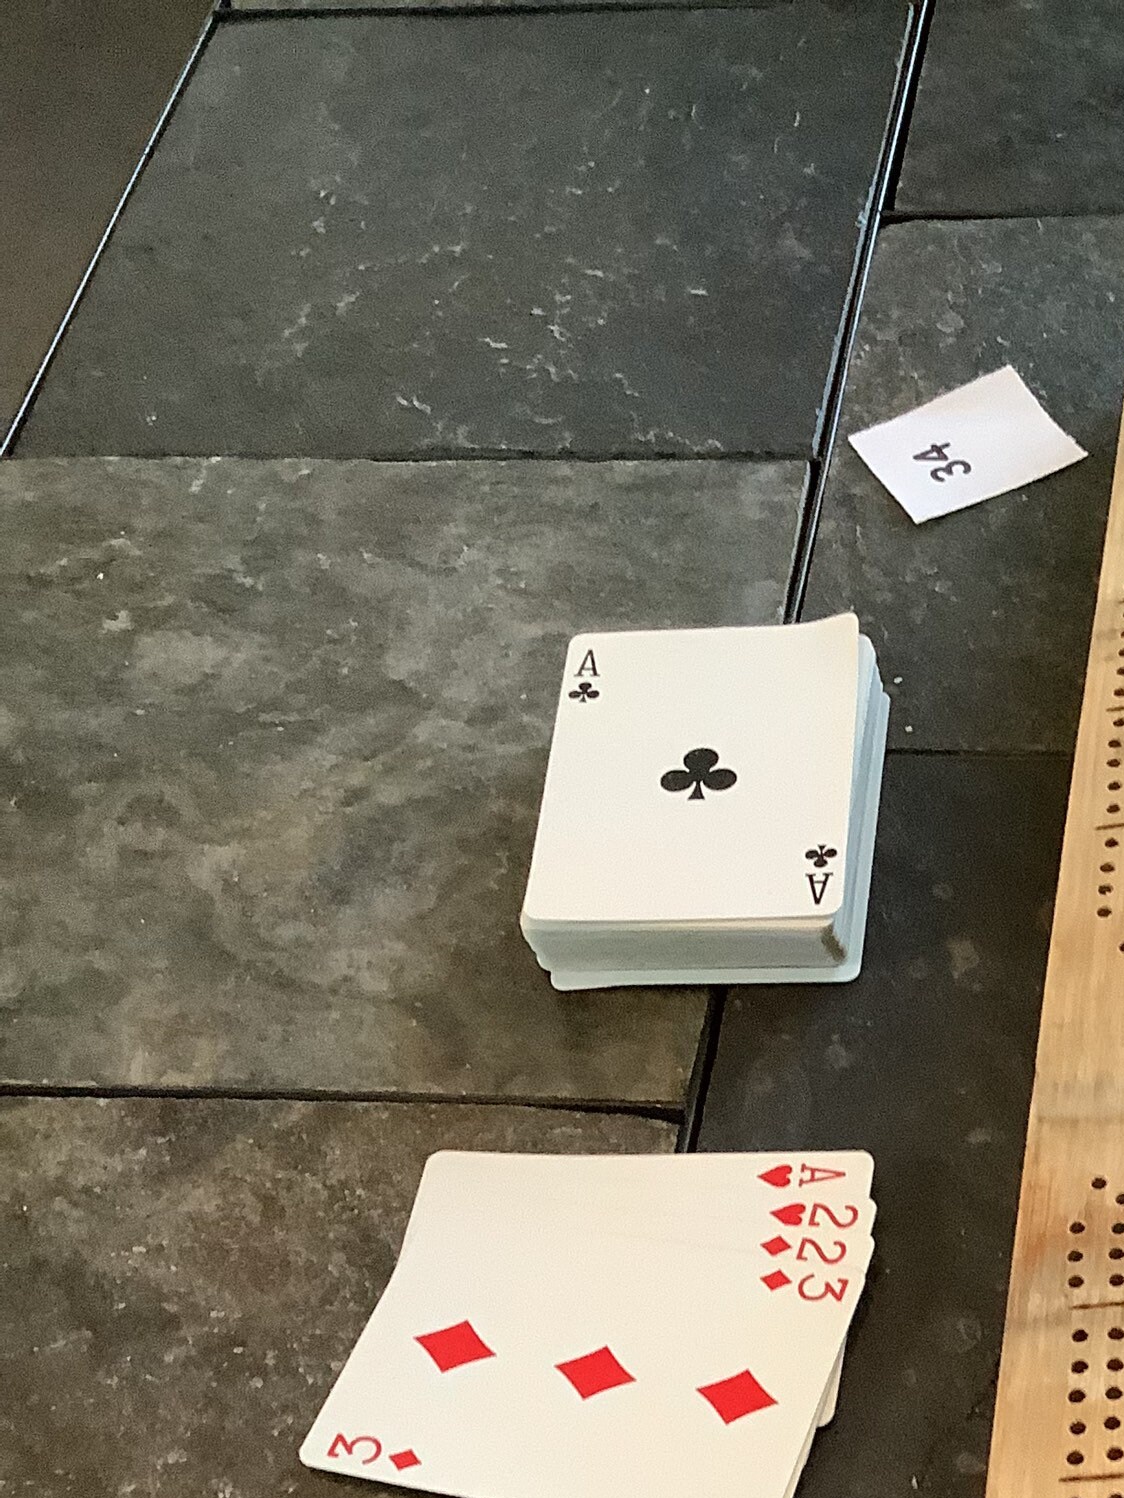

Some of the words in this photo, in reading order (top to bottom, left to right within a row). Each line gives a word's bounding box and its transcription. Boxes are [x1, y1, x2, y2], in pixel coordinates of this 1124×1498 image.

[913, 442, 971, 482] 34
[574, 649, 600, 676] A
[806, 873, 833, 905] A
[798, 1164, 846, 1186] A
[808, 1203, 859, 1229] 2
[796, 1236, 847, 1265] 2
[797, 1274, 849, 1302] 3
[327, 1432, 382, 1464] 3
